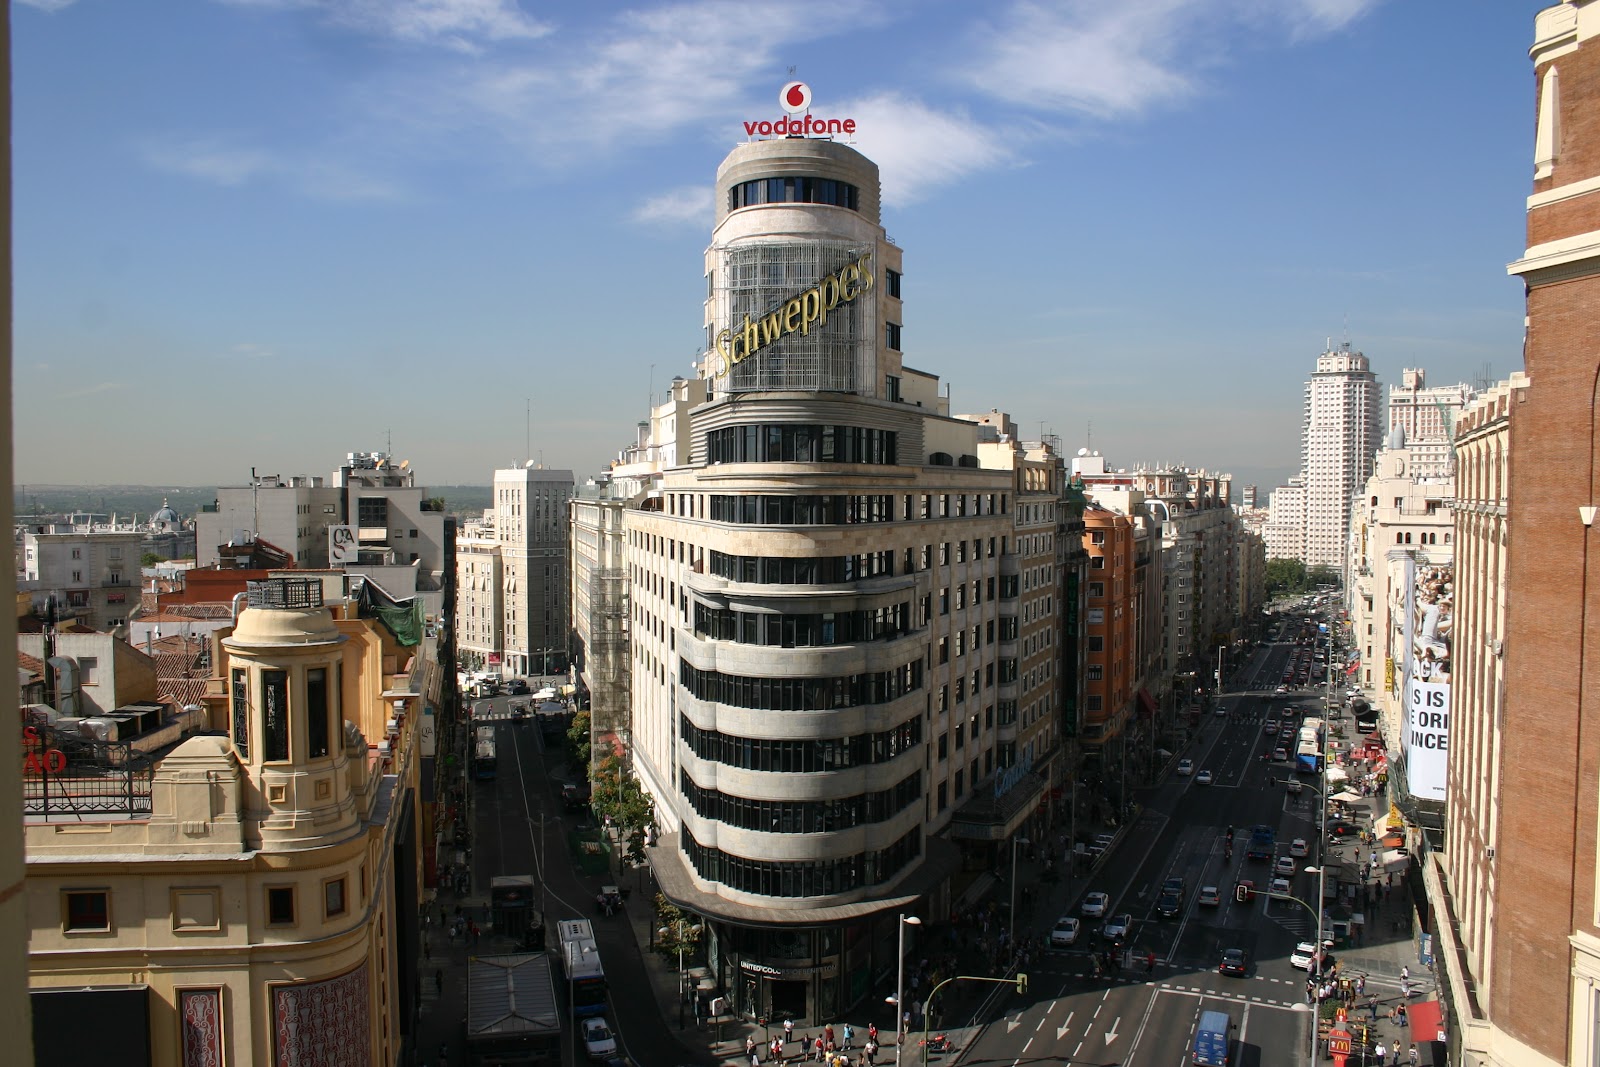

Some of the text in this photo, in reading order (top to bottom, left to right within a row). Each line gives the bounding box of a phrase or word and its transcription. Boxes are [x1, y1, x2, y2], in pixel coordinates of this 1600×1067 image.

[743, 115, 856, 136] vodafone
[715, 252, 875, 380] Schweppes
[1067, 575, 1078, 637] HOTEL
[1426, 691, 1444, 708] IS
[1418, 711, 1448, 730] ORI
[740, 960, 762, 973] UNITED
